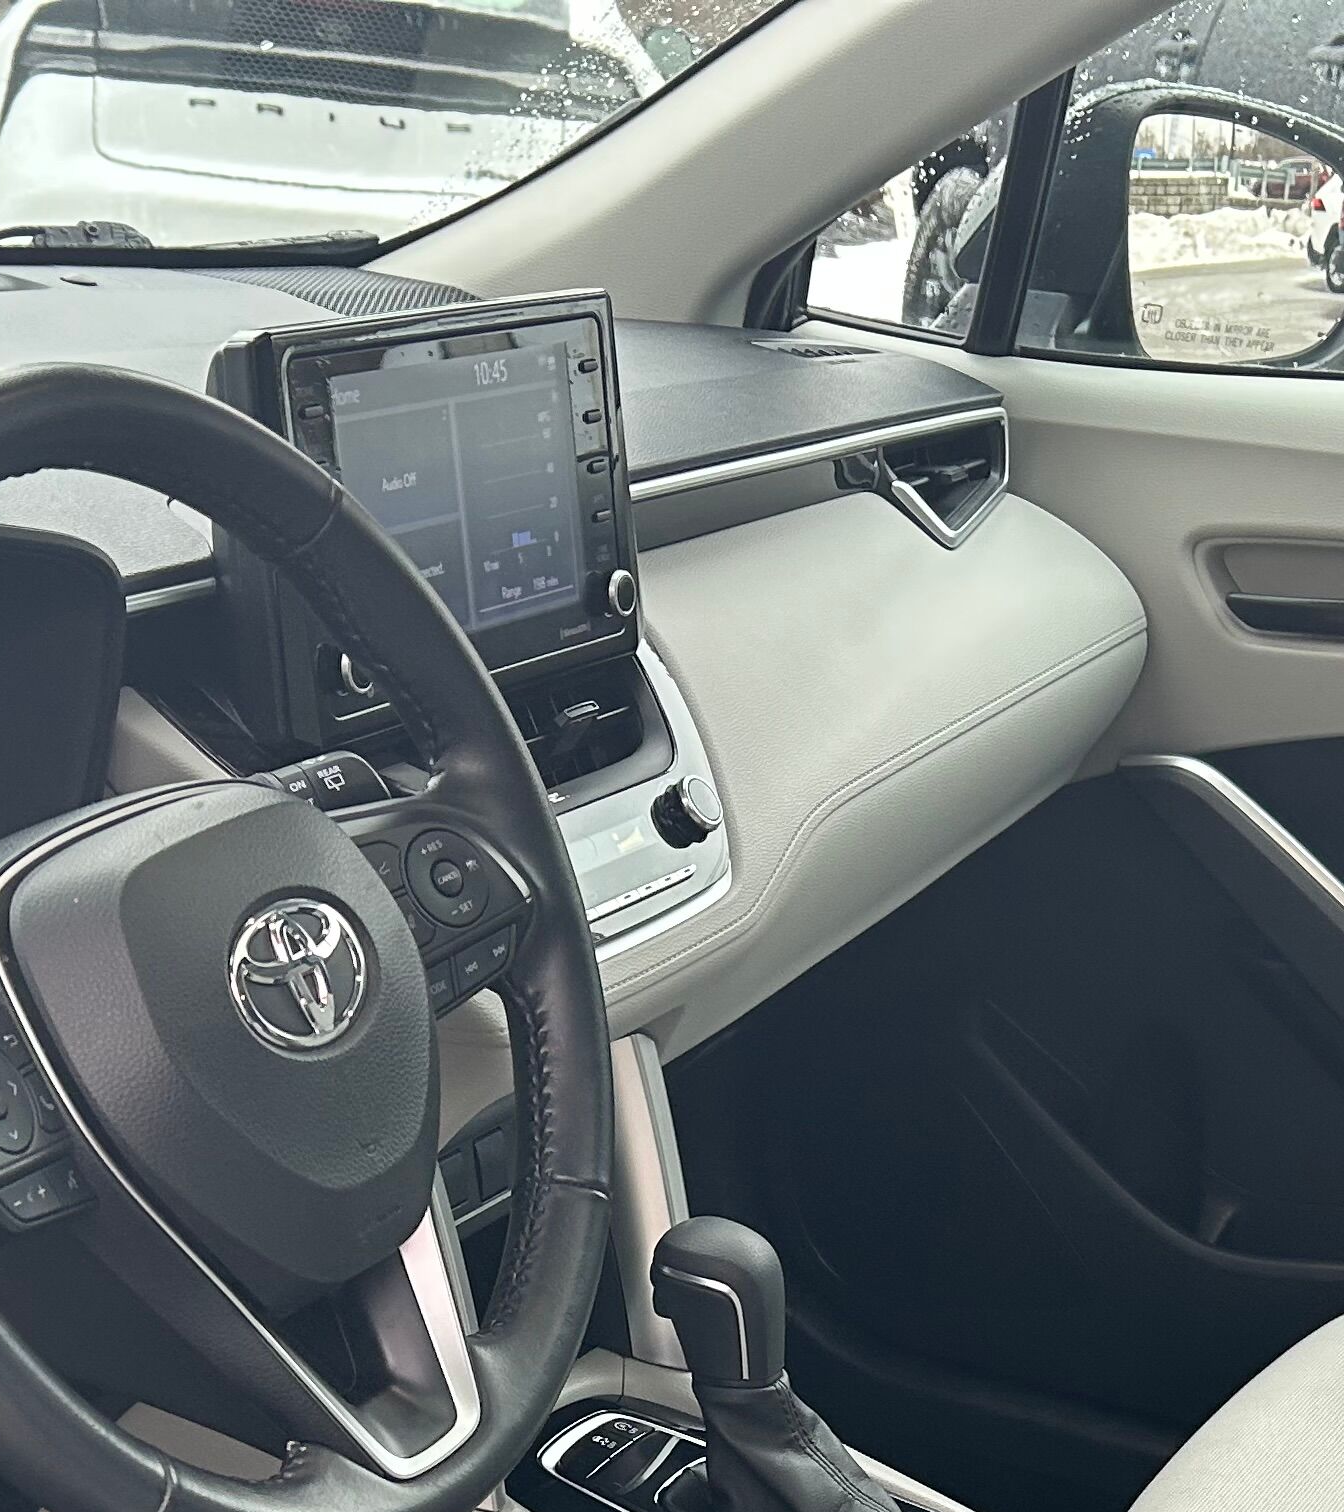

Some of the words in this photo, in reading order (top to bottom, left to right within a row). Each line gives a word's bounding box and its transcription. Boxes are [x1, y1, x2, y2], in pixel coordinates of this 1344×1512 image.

[1164, 329, 1196, 342] CLOSER
[1200, 333, 1220, 345] THAN
[1224, 336, 1244, 347] THEY
[473, 359, 508, 386] 10:45
[316, 765, 342, 779] REAR
[289, 779, 307, 793] ON
